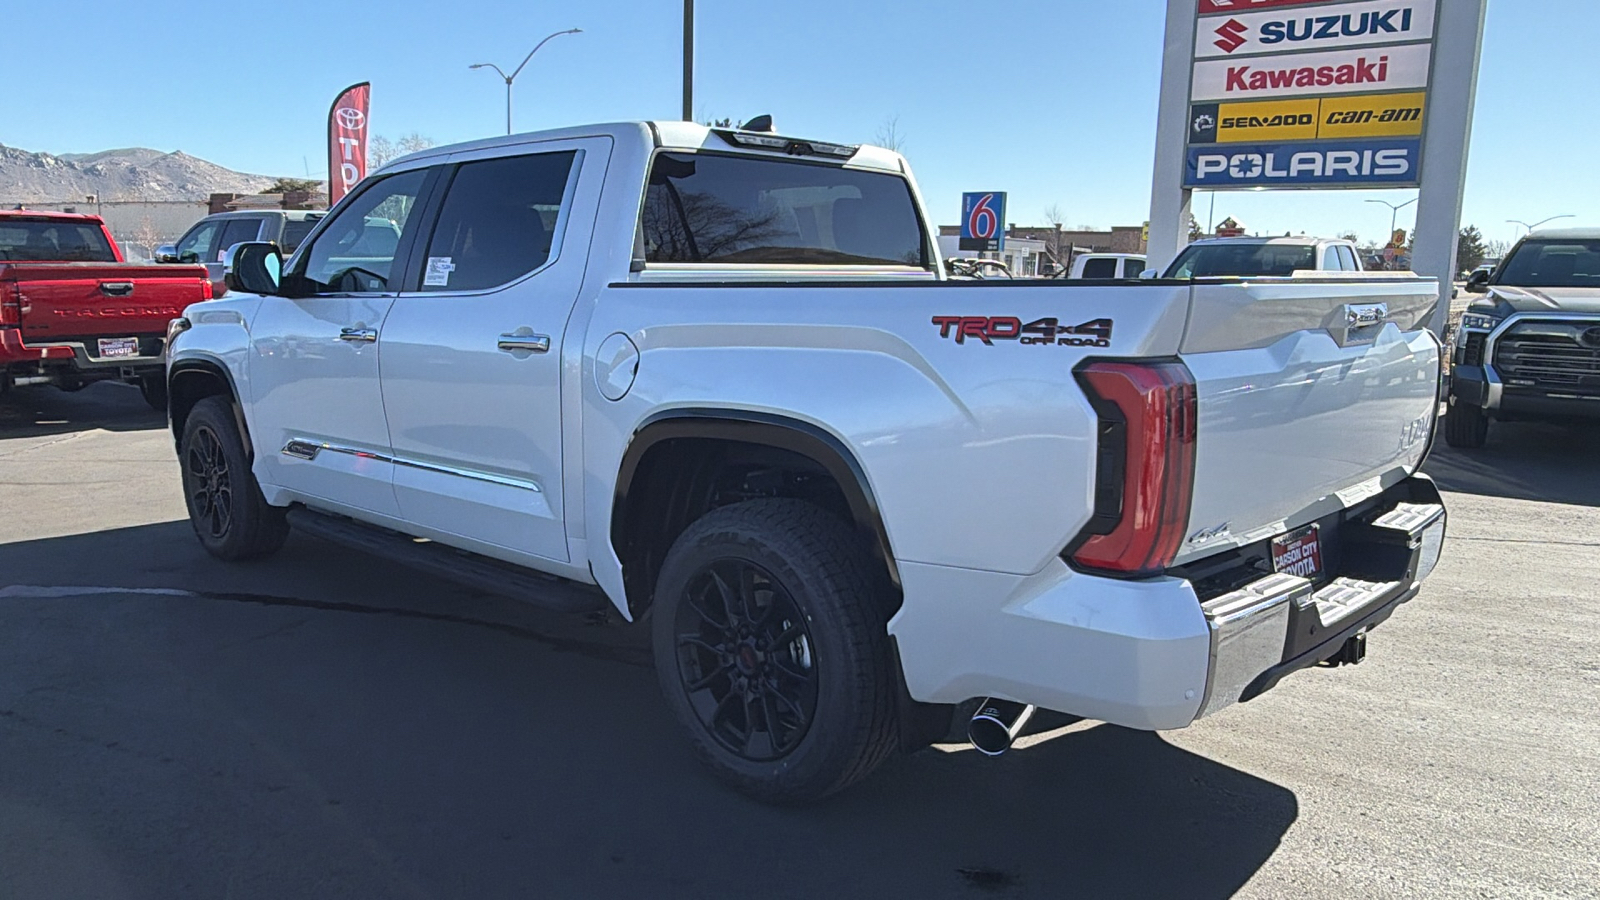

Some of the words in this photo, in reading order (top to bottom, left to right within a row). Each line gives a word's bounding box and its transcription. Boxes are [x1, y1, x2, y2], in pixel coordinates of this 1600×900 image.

[1259, 8, 1412, 44] SUZUKI
[1226, 55, 1388, 92] Kawasaki
[1196, 149, 1410, 179] POLARIS
[969, 194, 997, 239] 6
[53, 307, 179, 316] TACOMA
[932, 315, 1023, 346] TRD
[1021, 317, 1113, 340] 4x4
[1019, 336, 1056, 346] OFF
[1057, 337, 1111, 348] ROAD
[105, 347, 133, 355] TOYOTA
[1275, 546, 1302, 570] CARSON
[1301, 540, 1318, 557] CITY
